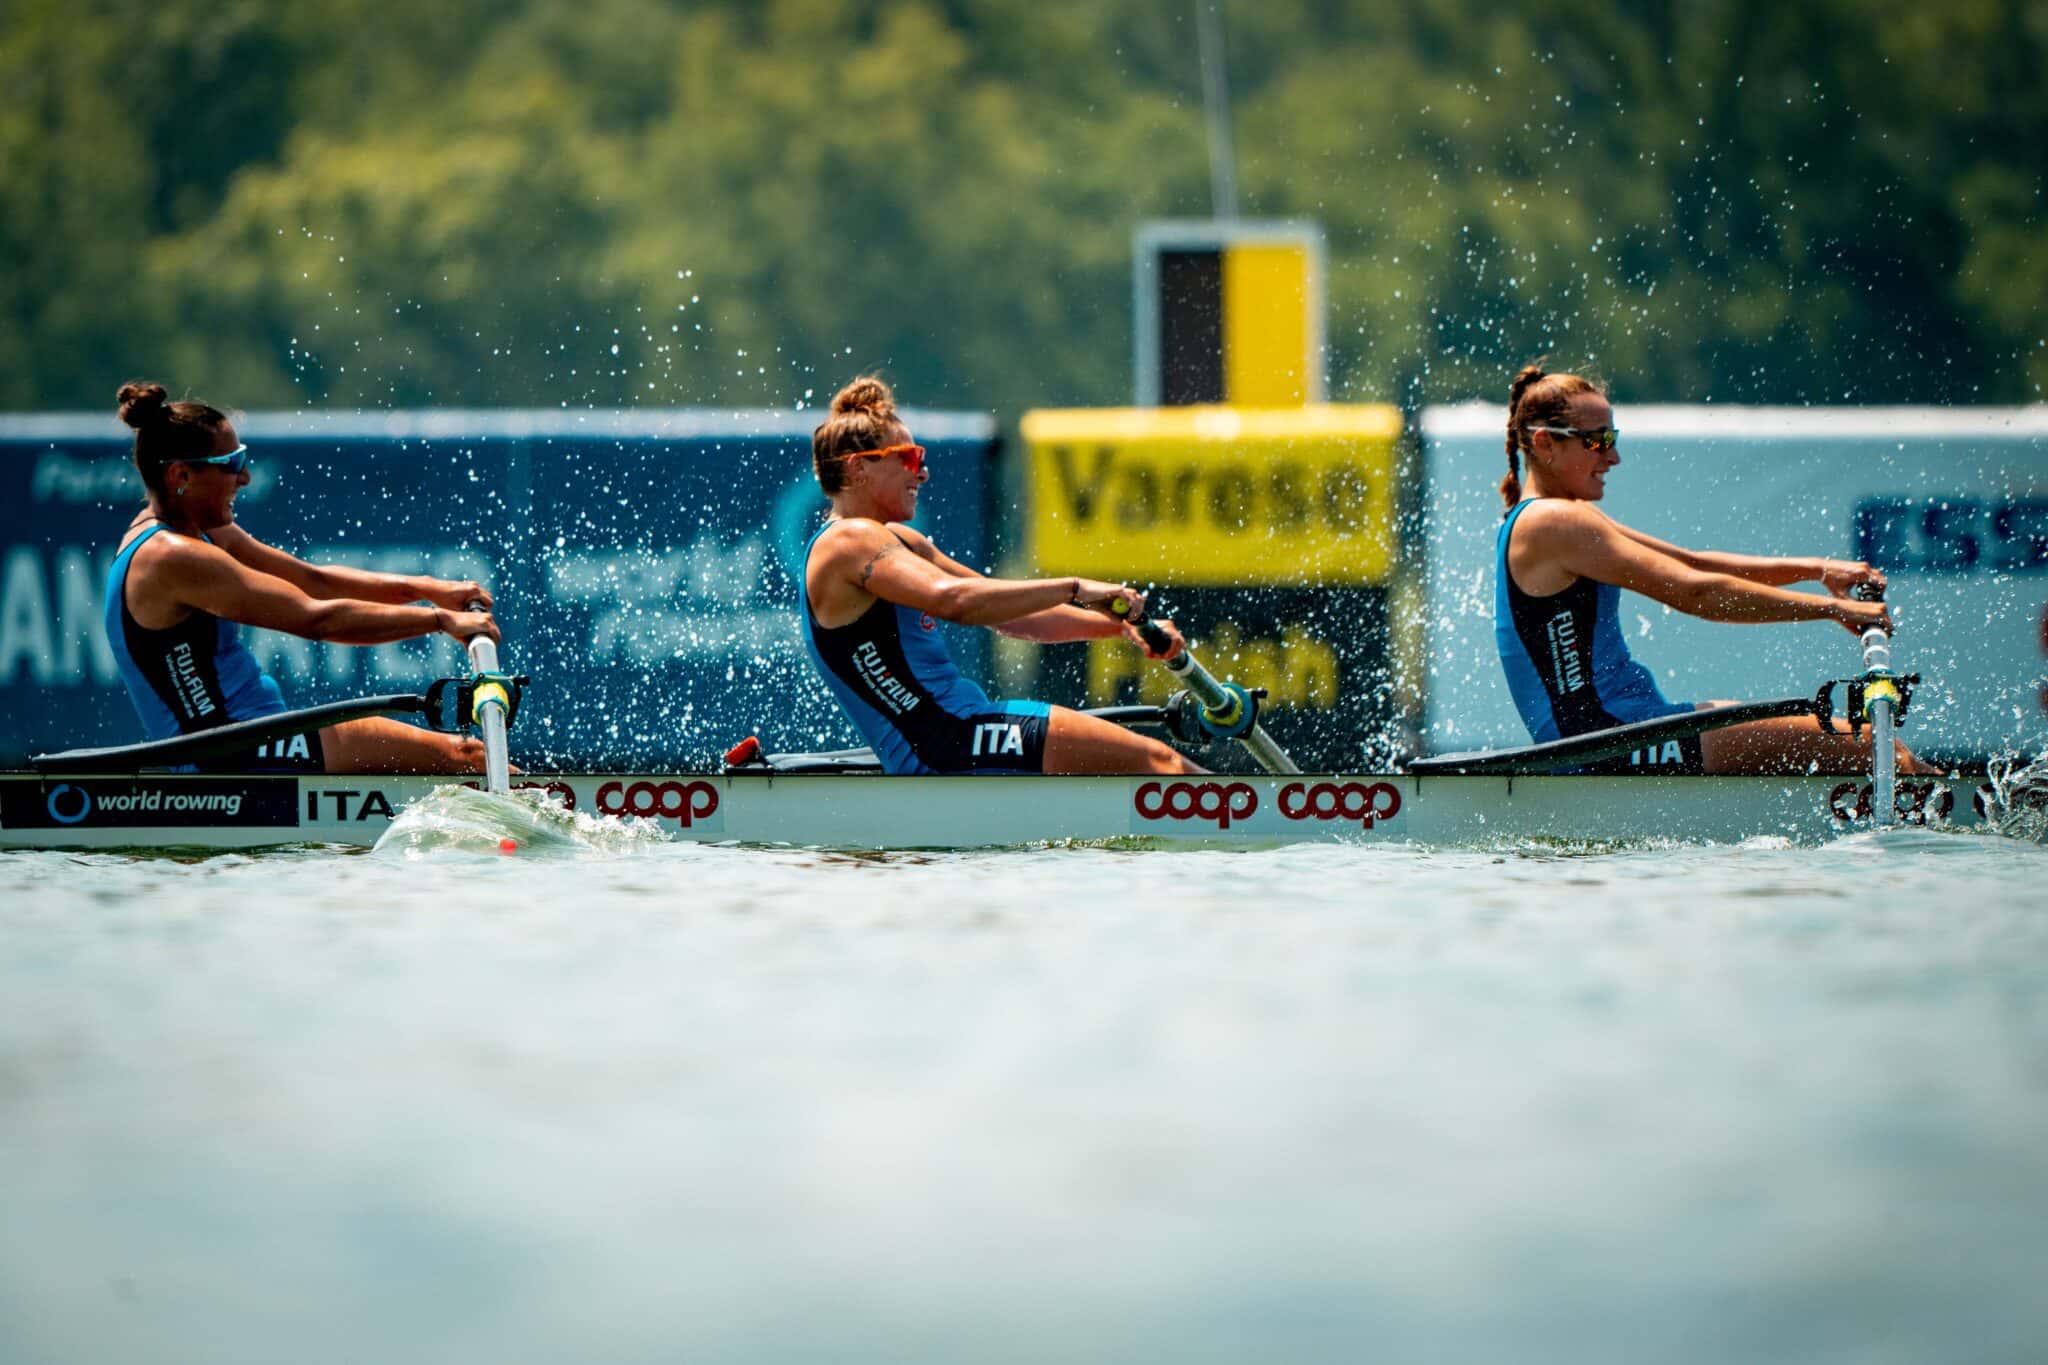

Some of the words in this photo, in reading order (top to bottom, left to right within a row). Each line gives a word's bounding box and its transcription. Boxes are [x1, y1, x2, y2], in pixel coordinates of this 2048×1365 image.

[1052, 446, 1371, 535] Varese
[1555, 610, 1585, 692] FUJIFILM
[173, 642, 216, 716] FUJIFILM
[857, 641, 920, 711] FUJIFILM
[972, 723, 1024, 756] ITA
[97, 790, 162, 811] world
[164, 795, 243, 816] rowing
[307, 789, 396, 821] ITA
[596, 781, 719, 828] coop
[1134, 782, 1258, 829] coop
[1277, 782, 1402, 829] coop
